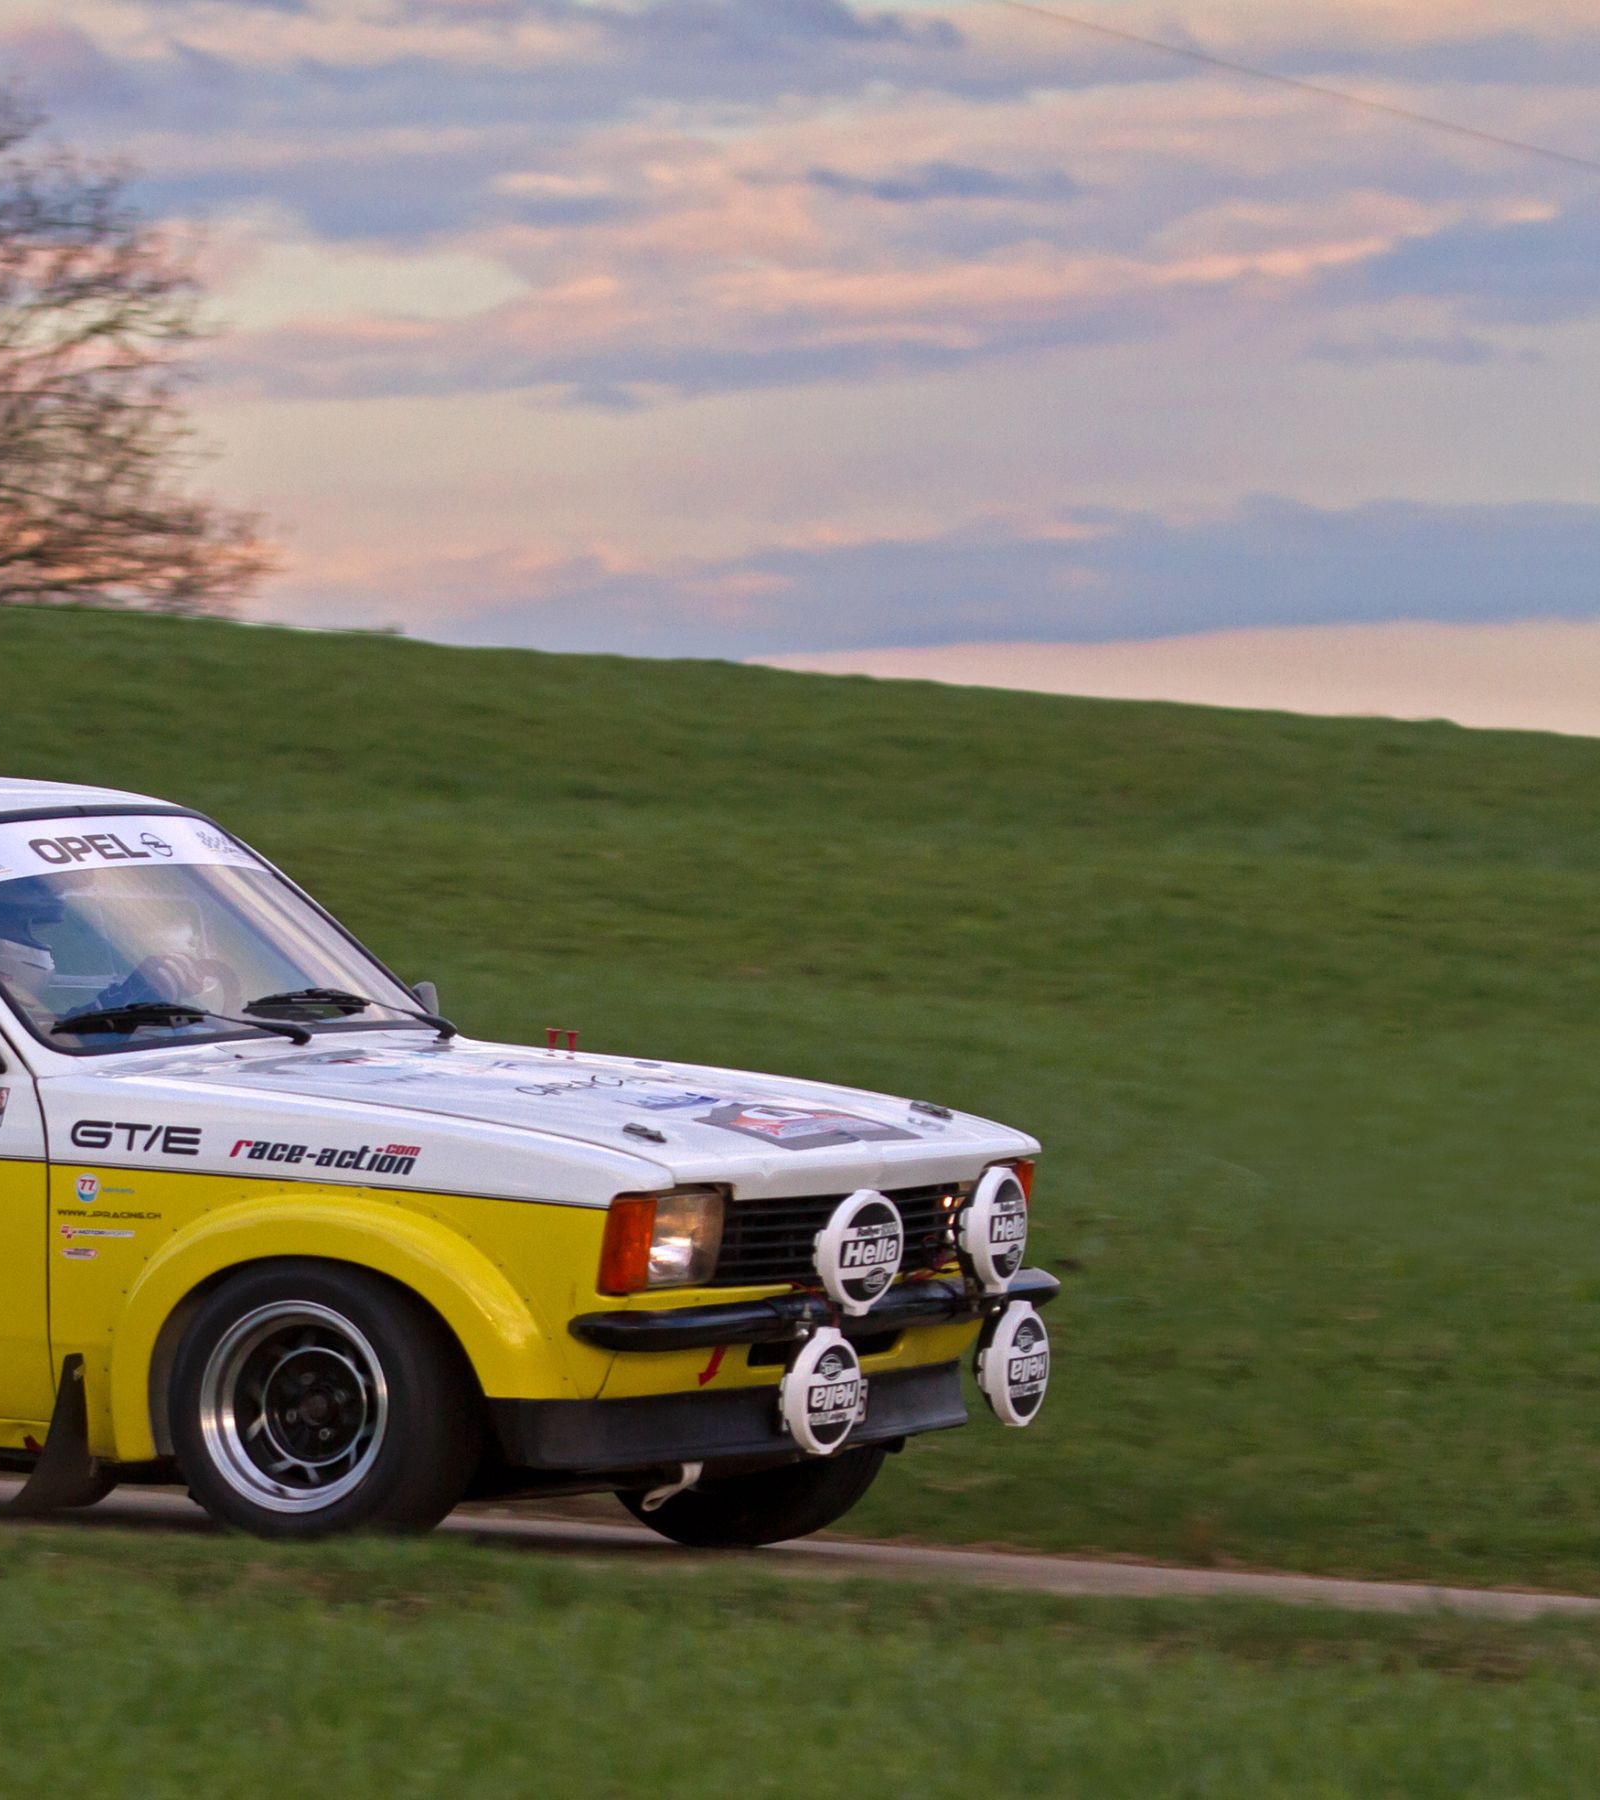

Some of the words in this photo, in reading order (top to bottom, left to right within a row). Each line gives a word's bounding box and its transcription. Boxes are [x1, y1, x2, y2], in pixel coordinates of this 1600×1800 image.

[28, 833, 152, 865] OPEL
[80, 1178, 96, 1191] 77
[842, 1237, 898, 1267] Hella
[1010, 1353, 1048, 1383] Hella
[810, 1381, 858, 1411] Hella
